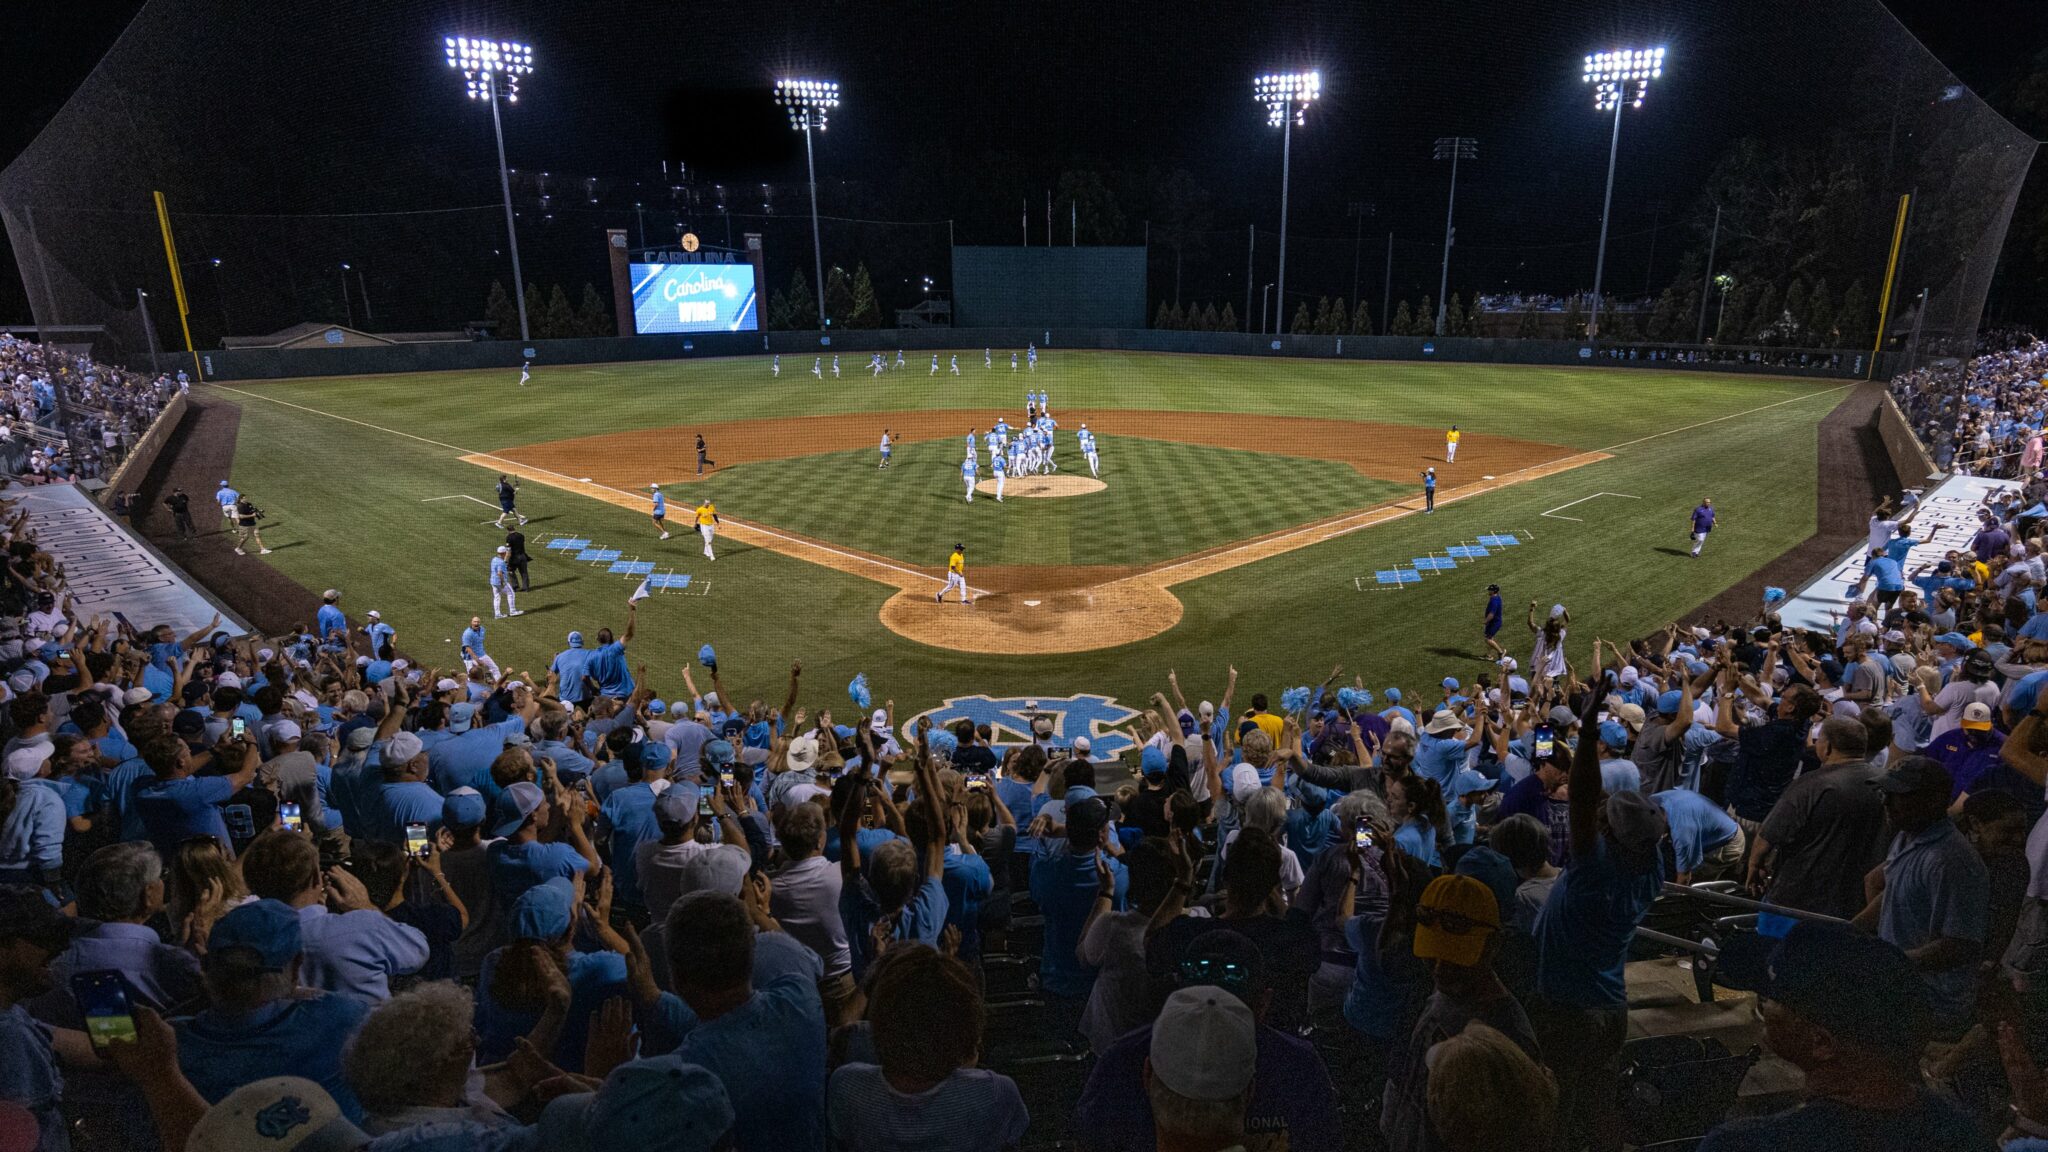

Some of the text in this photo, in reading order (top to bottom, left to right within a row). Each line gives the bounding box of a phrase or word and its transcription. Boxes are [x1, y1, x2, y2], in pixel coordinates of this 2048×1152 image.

[644, 251, 736, 264] CAROLINA
[663, 271, 724, 302] Carolina
[678, 301, 717, 323] WINS
